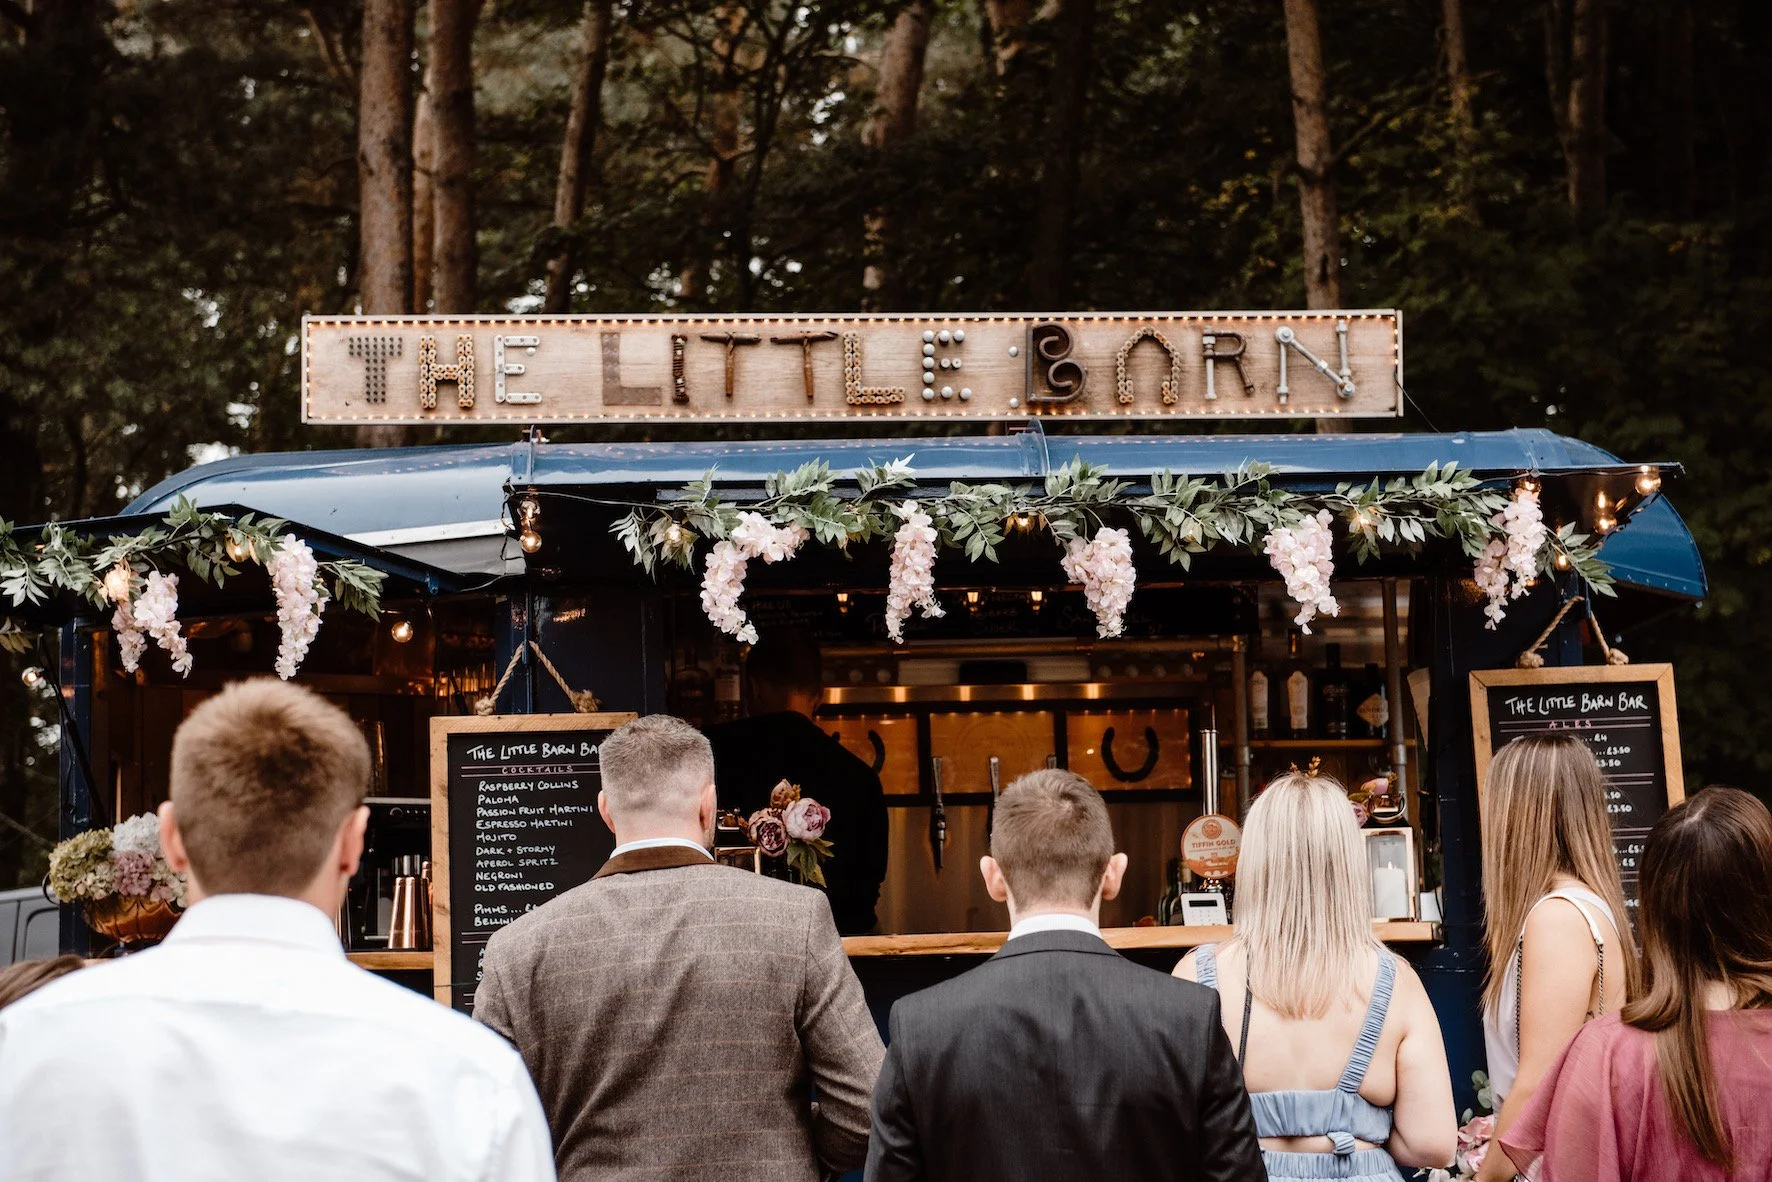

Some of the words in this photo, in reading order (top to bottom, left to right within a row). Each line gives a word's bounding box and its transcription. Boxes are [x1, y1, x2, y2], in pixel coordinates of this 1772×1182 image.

[348, 333, 542, 409] THE
[600, 330, 972, 406] LITTLE
[1025, 319, 1356, 404] BARN
[1505, 696, 1536, 716] THE
[1539, 695, 1576, 715] LITTLE
[1580, 693, 1614, 713] BARN
[1618, 692, 1648, 712] BAR
[1548, 720, 1592, 729] ALES
[466, 744, 496, 761] THE
[500, 744, 538, 760] LITTLE
[541, 743, 575, 758] BARN
[580, 742, 600, 757] BA
[501, 765, 574, 774] COCKTAILS
[478, 781, 534, 792] RASPBERRY
[537, 780, 579, 790] COLLINS
[478, 795, 519, 805] PALOMA
[476, 807, 516, 817] PASSION
[519, 806, 545, 815] FRUIT
[549, 804, 593, 815] MARTINI
[476, 820, 527, 829] ESPRESSO
[530, 819, 573, 829] MARTINI
[476, 832, 517, 843] MOJITO
[475, 846, 504, 856] DARK
[516, 845, 556, 855] STORMY
[476, 860, 514, 868] APEROL
[518, 858, 559, 867] SPRITZ
[475, 872, 523, 881] NEGRONI
[474, 883, 496, 892] OLD
[498, 882, 555, 891] FASHIONED
